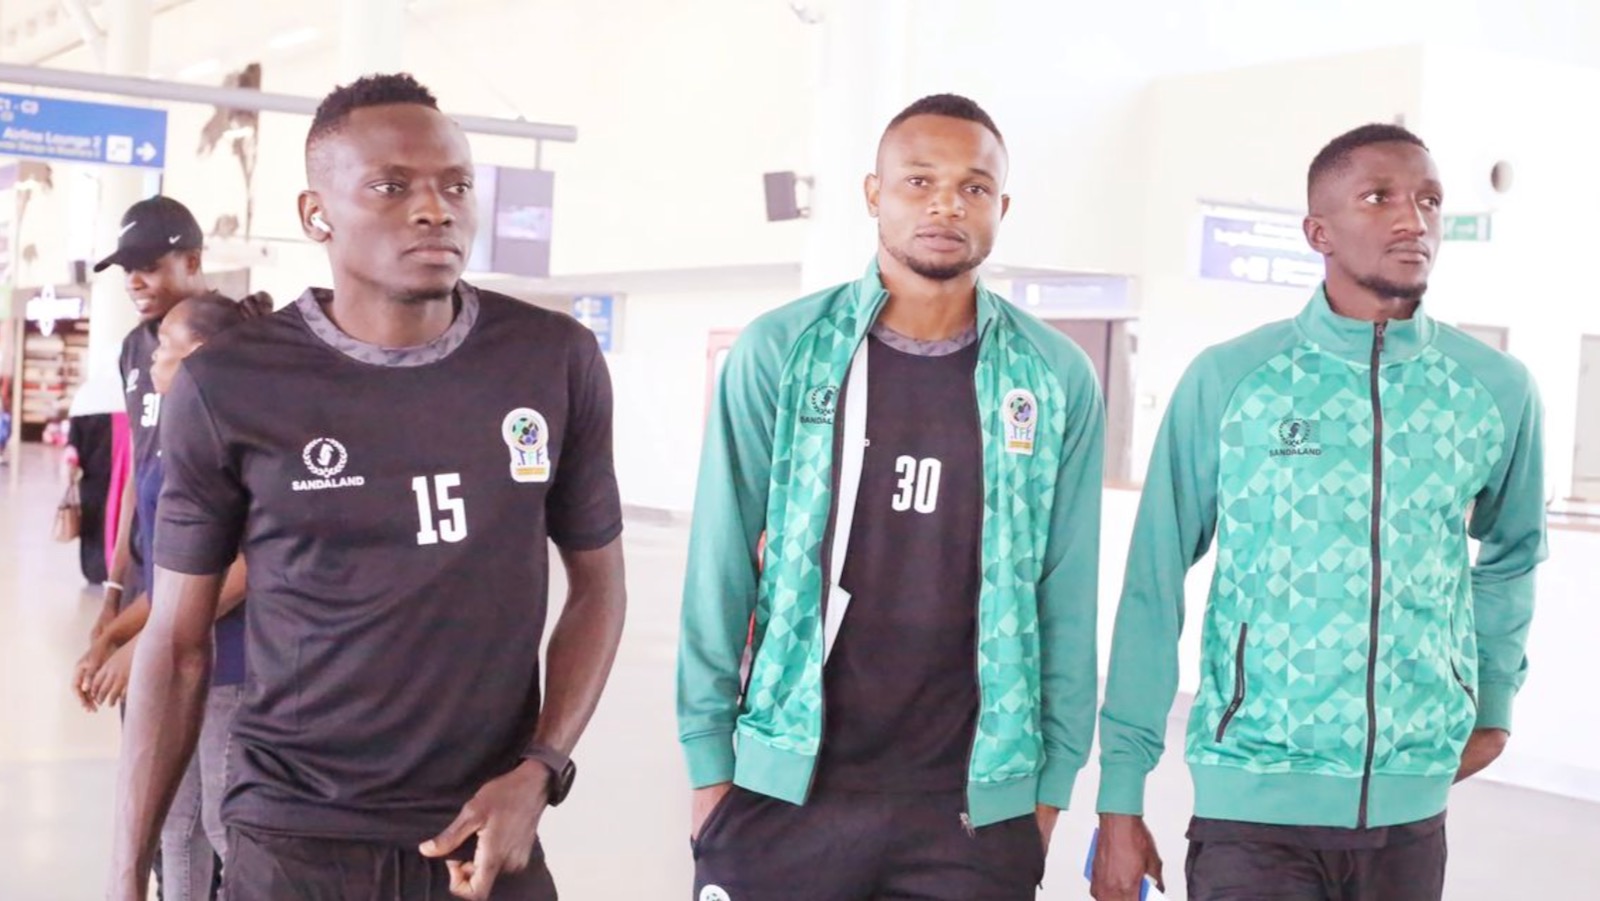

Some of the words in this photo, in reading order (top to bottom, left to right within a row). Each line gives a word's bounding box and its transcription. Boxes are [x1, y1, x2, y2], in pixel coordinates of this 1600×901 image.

[1269, 447, 1321, 457] SANDALAND
[291, 476, 365, 491] SANDALAND
[891, 455, 942, 514] 30
[411, 472, 468, 545] 15
